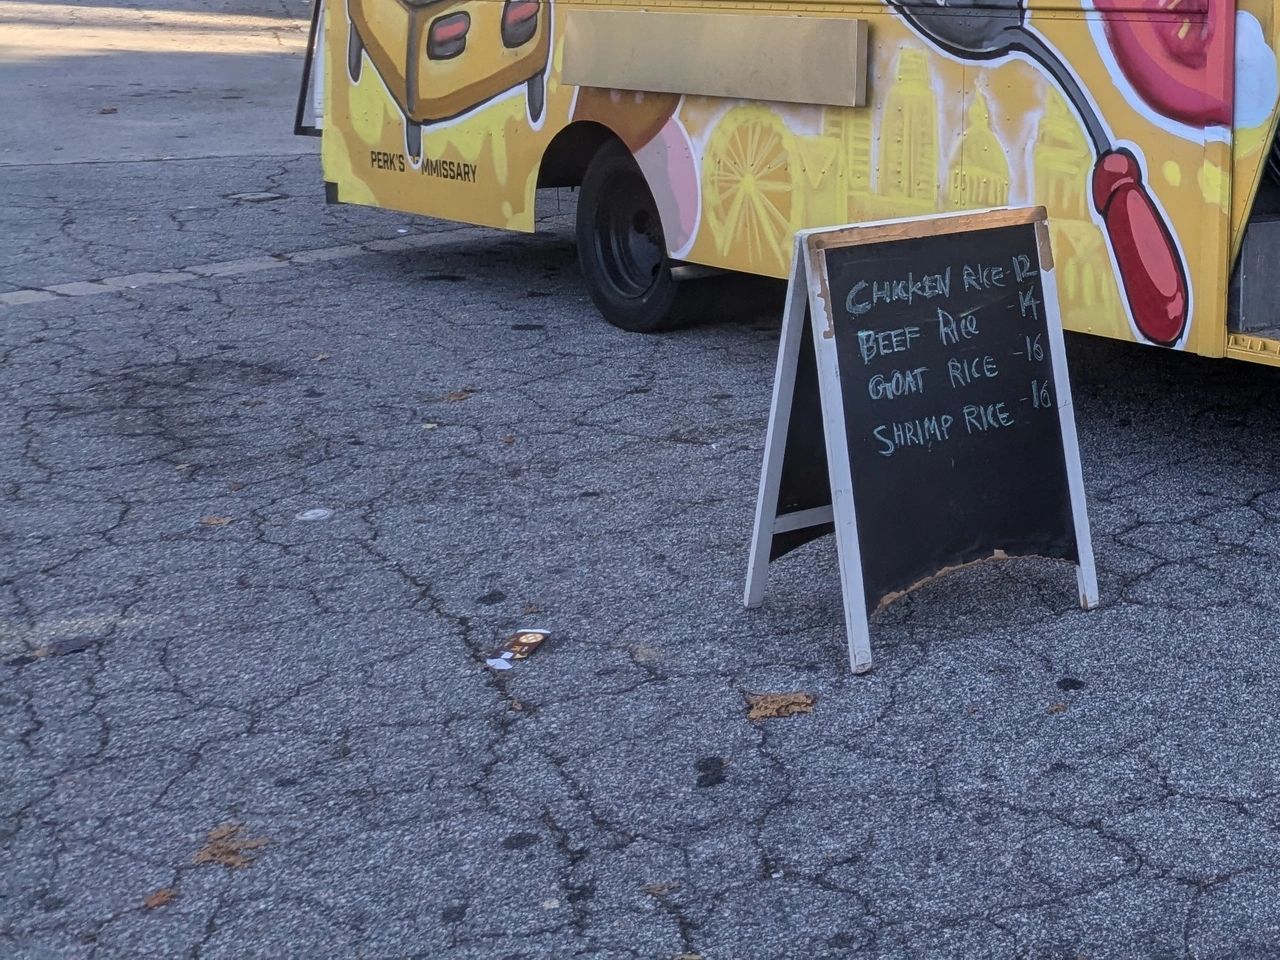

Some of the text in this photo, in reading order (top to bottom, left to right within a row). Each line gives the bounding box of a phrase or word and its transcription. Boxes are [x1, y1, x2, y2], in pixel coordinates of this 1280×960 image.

[370, 151, 477, 183] PERK'S MMISSARY
[845, 266, 951, 314] CHICKEN
[963, 264, 1006, 292] RICE
[857, 327, 921, 365] BEEF
[868, 367, 928, 400] GOAT
[948, 355, 999, 389] RICE
[873, 415, 953, 457] SHRIMP
[963, 401, 1014, 434] RICE
